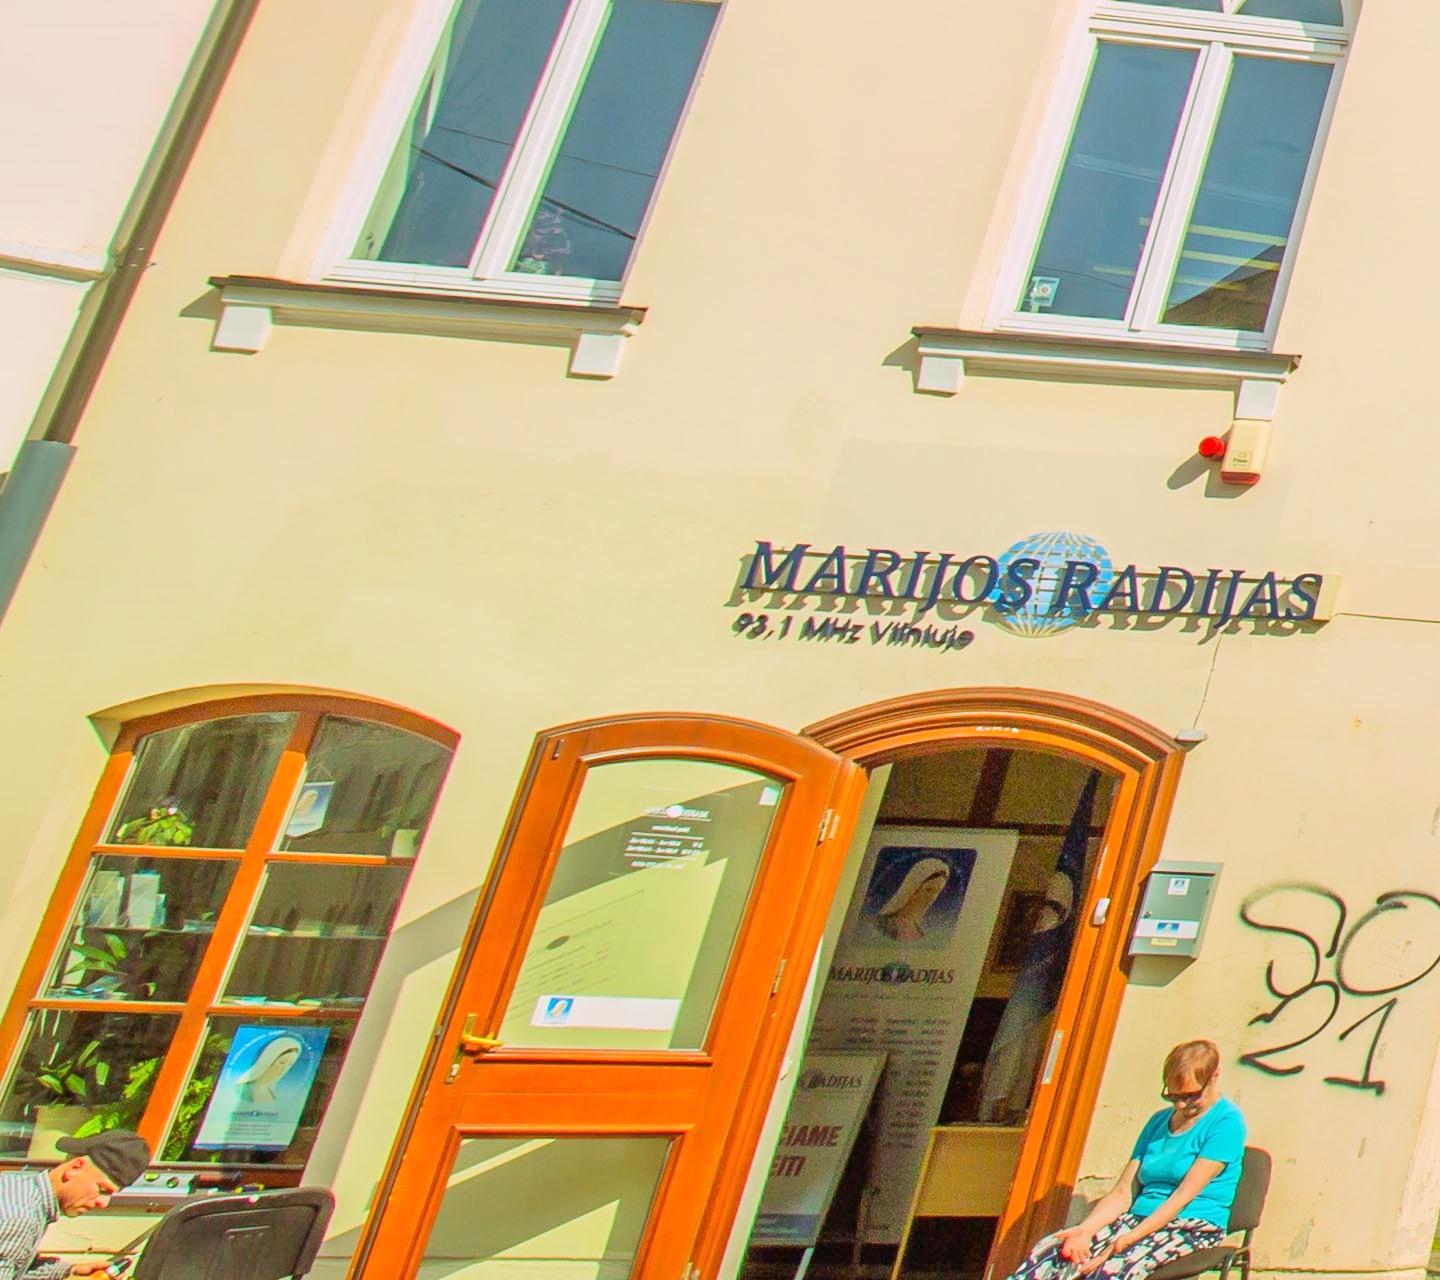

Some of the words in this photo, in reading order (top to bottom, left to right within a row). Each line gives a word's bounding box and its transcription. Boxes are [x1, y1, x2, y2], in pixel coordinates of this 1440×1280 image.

[739, 540, 1041, 614] MARIJOS
[1048, 560, 1324, 629] RADIJAS
[797, 615, 864, 645] MHz
[869, 619, 976, 654] Vilniuje
